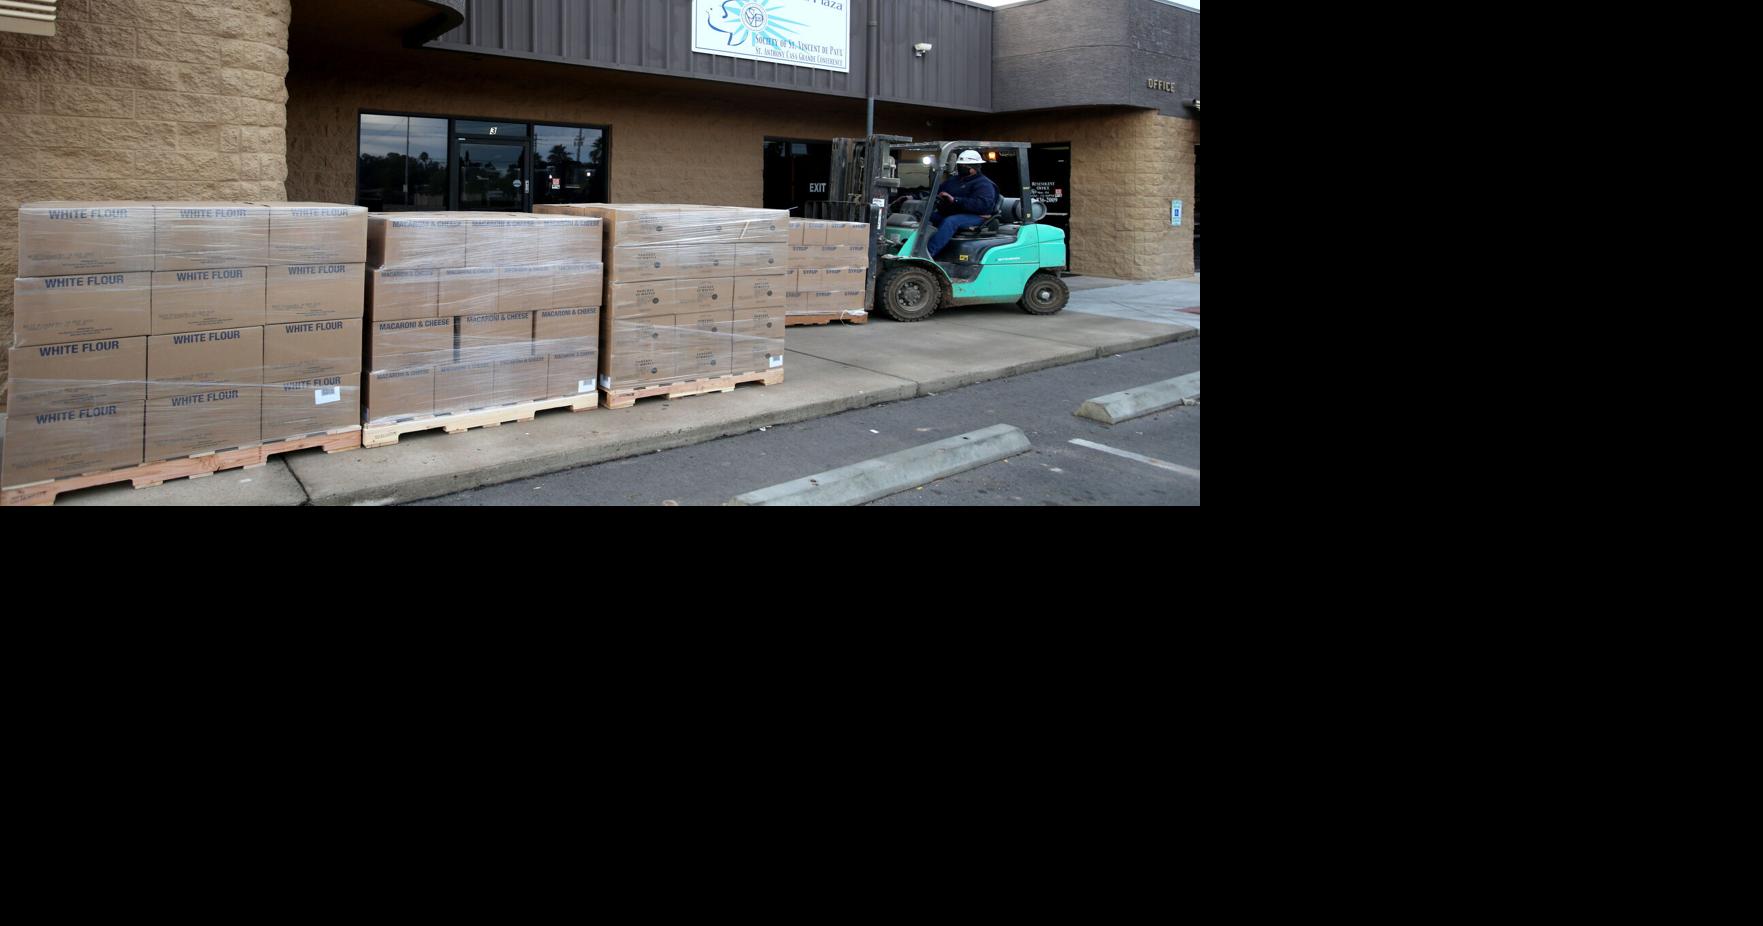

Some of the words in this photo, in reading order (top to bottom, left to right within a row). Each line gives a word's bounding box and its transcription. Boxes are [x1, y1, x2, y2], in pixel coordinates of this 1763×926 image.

[1147, 78, 1176, 93] OFFICE
[489, 127, 498, 135] 3
[809, 183, 827, 192] EXIT
[49, 210, 86, 220] WHITE
[91, 209, 128, 218] FLOUR
[180, 209, 211, 218] WHITE
[216, 209, 246, 217] FLOUR
[321, 208, 348, 216] FLOUR
[288, 265, 315, 275] WHITE
[319, 264, 345, 274] FLOUR
[176, 272, 208, 281] WHITE
[212, 270, 243, 279] FLOUR
[45, 277, 83, 288] WHITE
[87, 275, 124, 285] FLOUR
[467, 314, 500, 323] MACARONI
[507, 312, 528, 320] CHEESE
[286, 323, 313, 334] WHITE
[316, 321, 343, 331] FLOUR
[379, 322, 416, 330] MACARONI
[425, 319, 449, 327] CHEESE
[174, 333, 205, 344] WHITE
[209, 330, 240, 341] FLOUR
[40, 344, 78, 357] WHITE
[82, 340, 119, 352] FLOUR
[283, 380, 311, 392] WHITE
[314, 376, 341, 387] FLOUR
[172, 394, 204, 406] WHITE
[207, 390, 238, 402] FLOUR
[36, 412, 74, 424] WHITE
[80, 405, 116, 419] FLOUR
